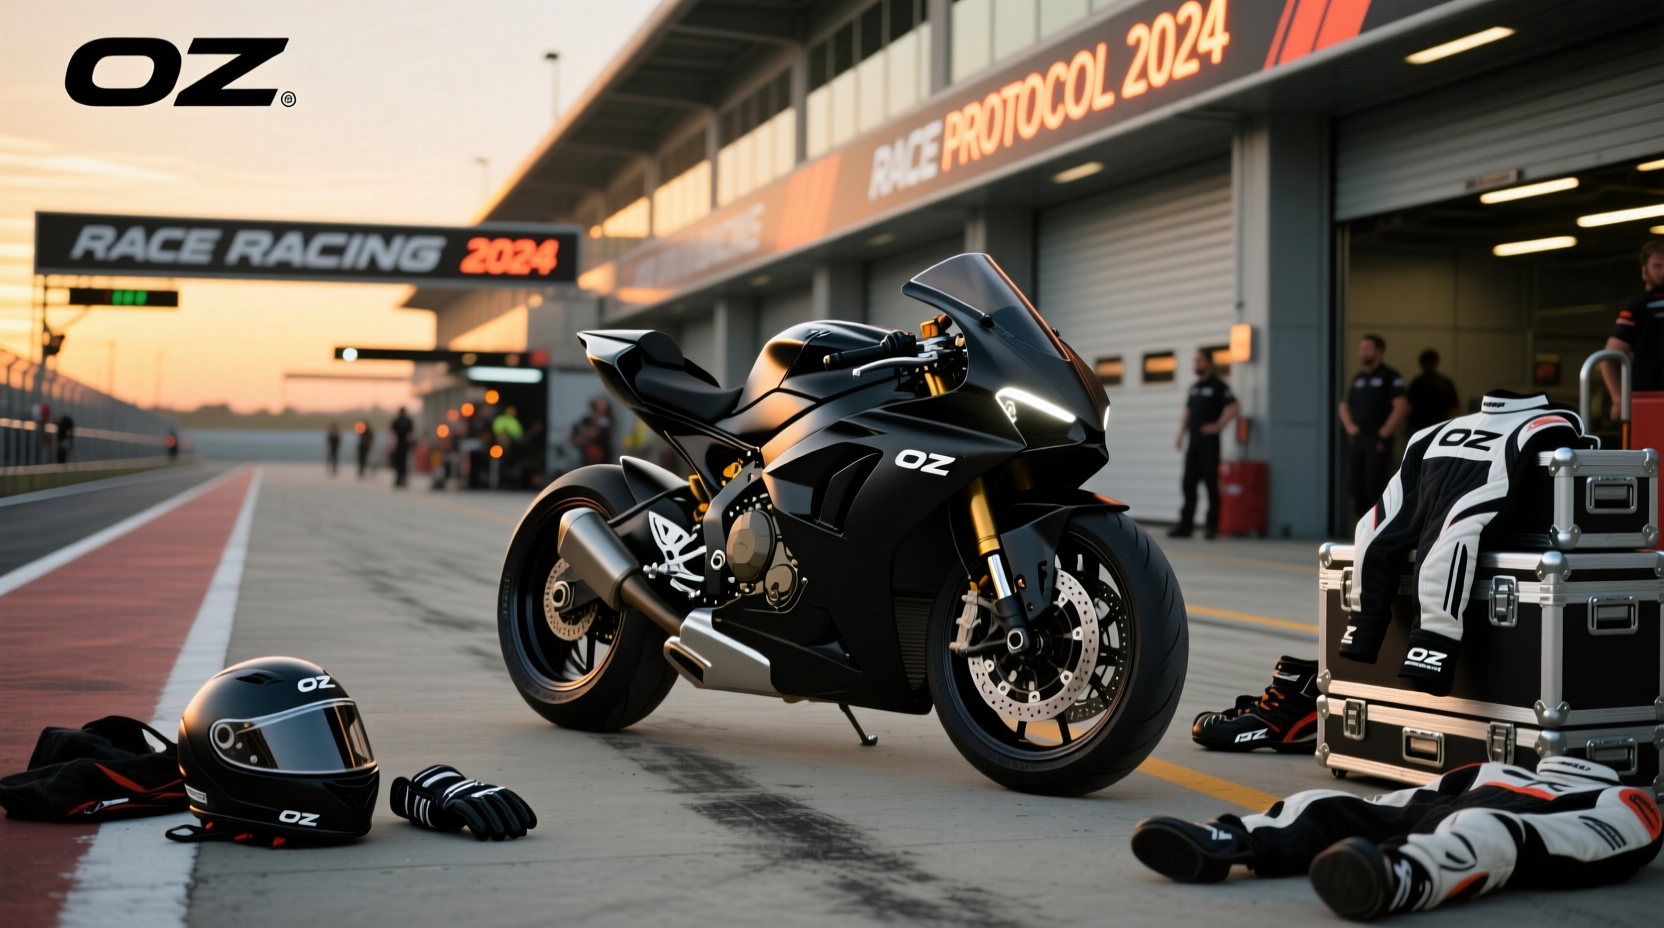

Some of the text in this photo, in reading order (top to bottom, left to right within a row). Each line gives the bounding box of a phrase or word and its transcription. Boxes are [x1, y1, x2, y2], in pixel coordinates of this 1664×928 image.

[868, 0, 1230, 201] RACE PROTOCOL 2024
[71, 226, 560, 275] RACE RACING 2024
[1439, 429, 1503, 452] OZ
[895, 449, 956, 476] OZ
[1407, 647, 1448, 666] OZ
[297, 675, 336, 693] OZ
[279, 810, 320, 826] OZ
